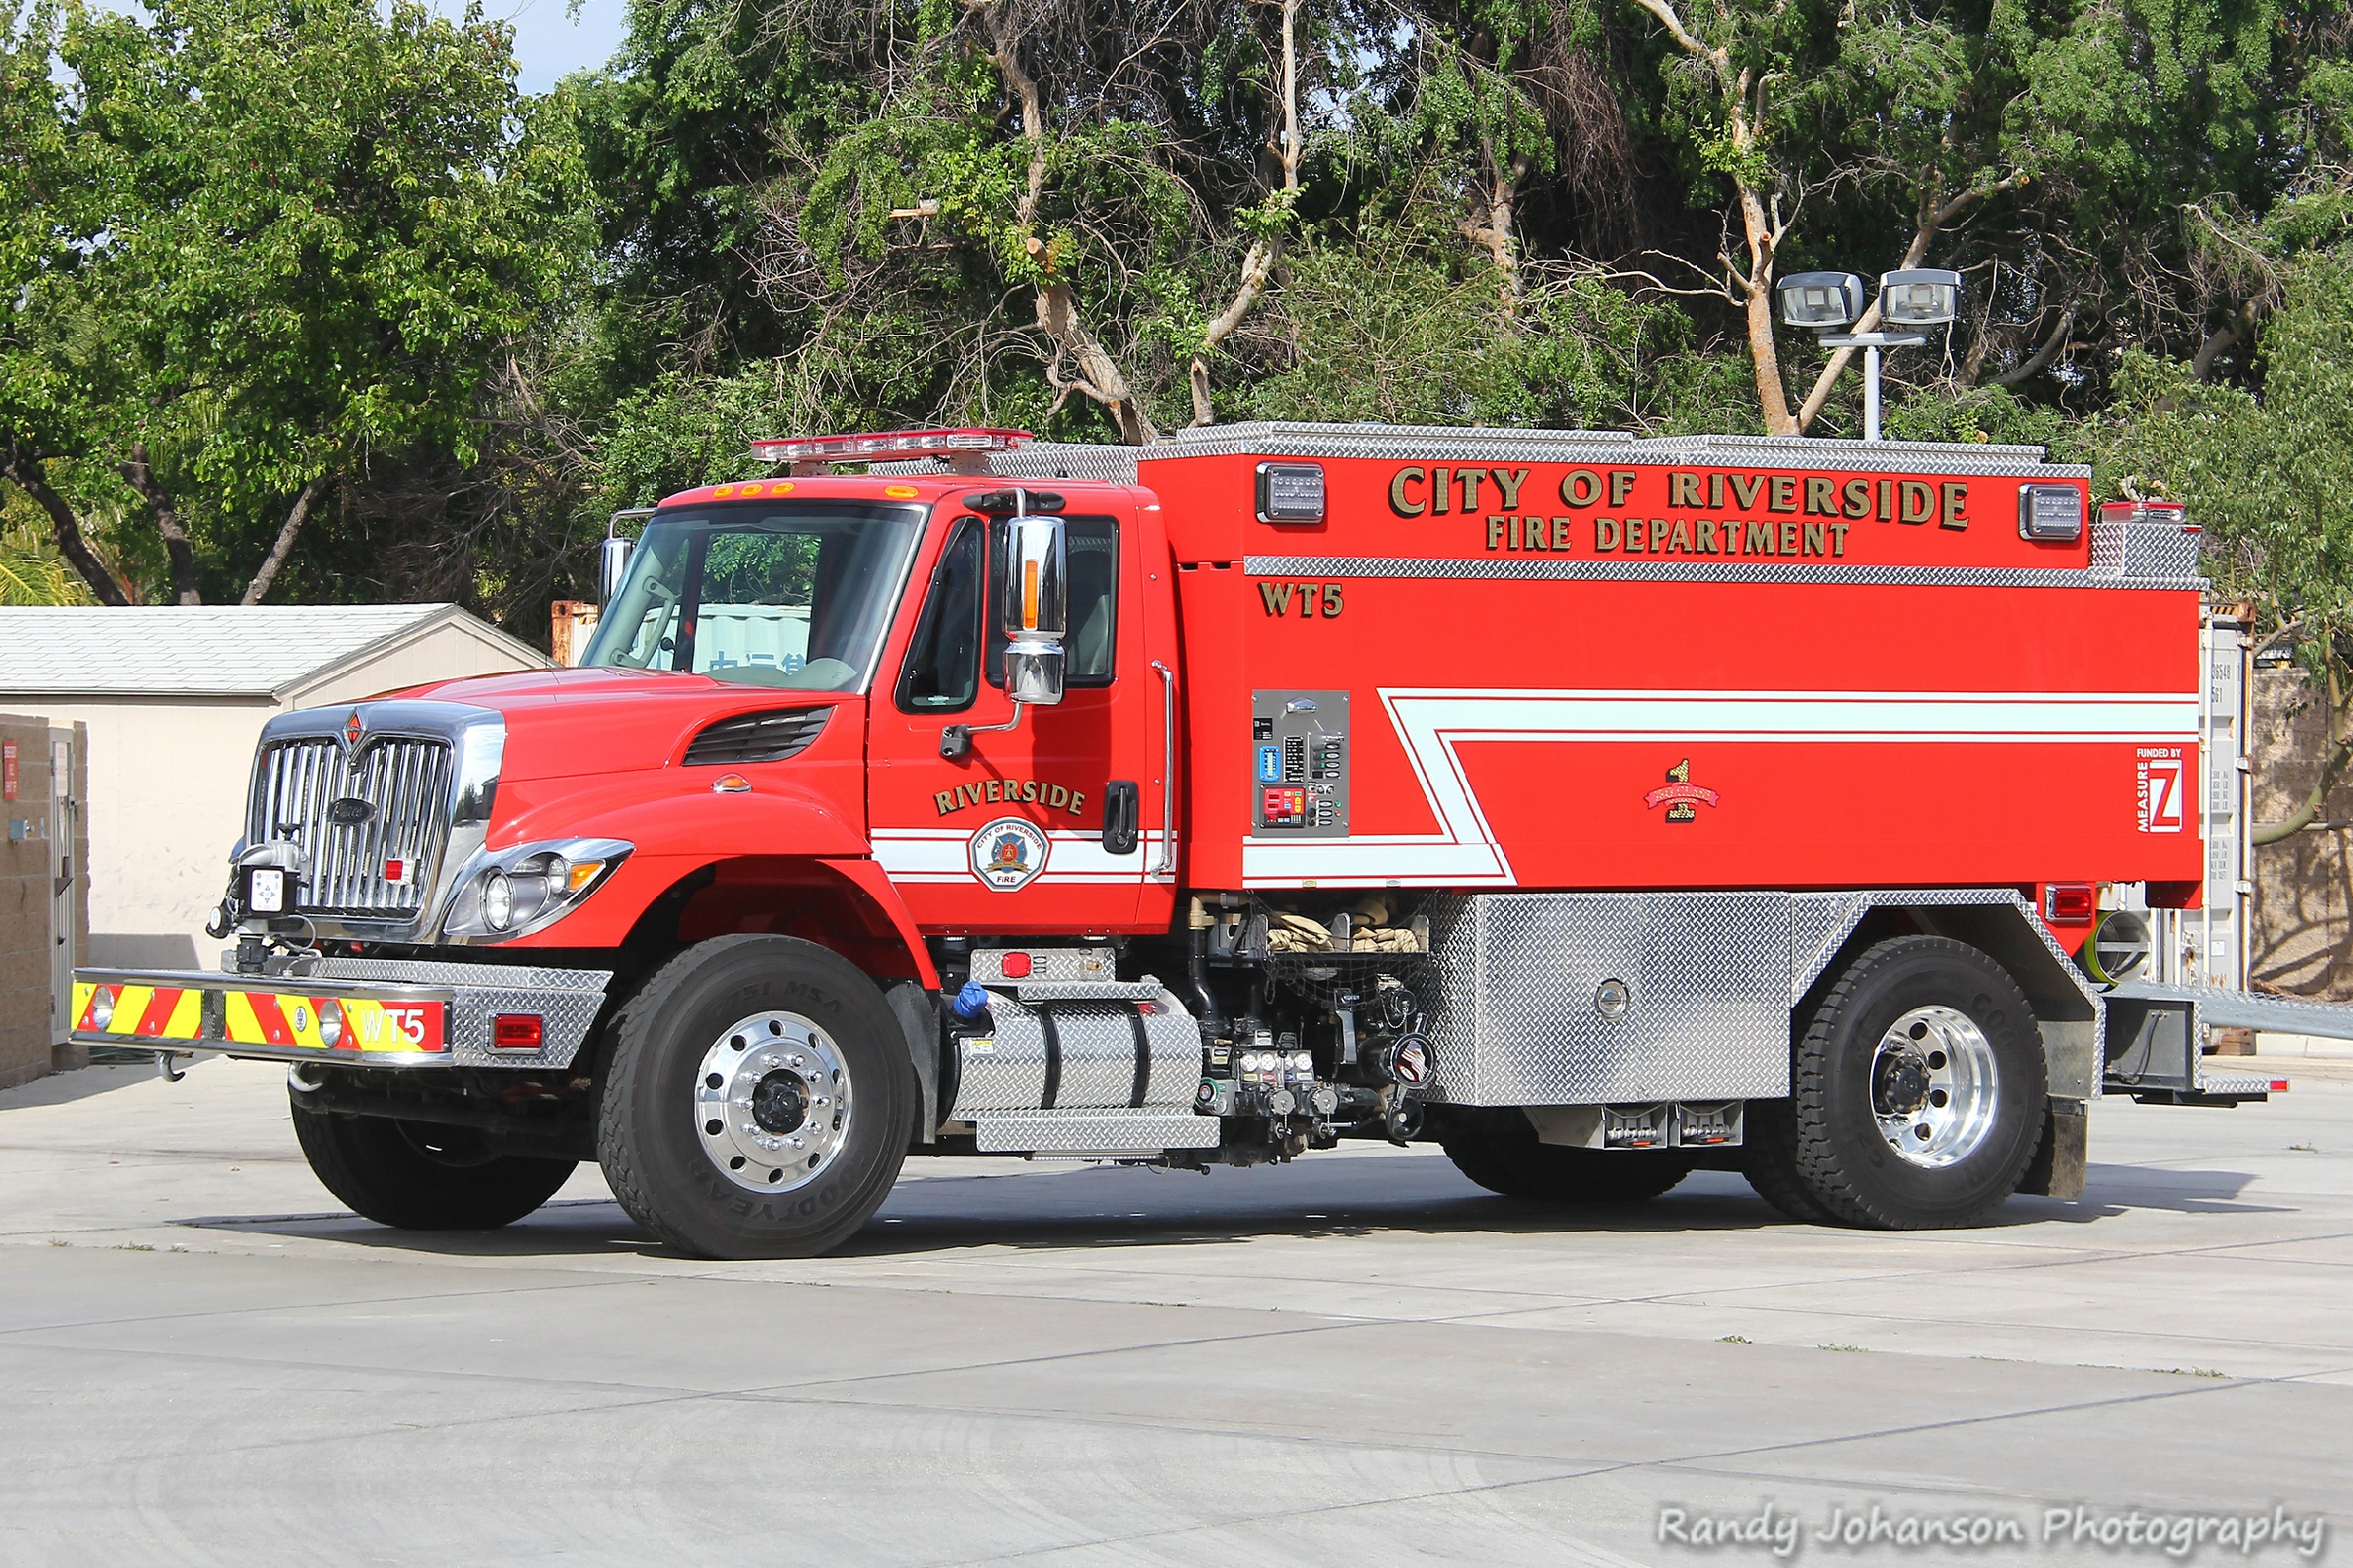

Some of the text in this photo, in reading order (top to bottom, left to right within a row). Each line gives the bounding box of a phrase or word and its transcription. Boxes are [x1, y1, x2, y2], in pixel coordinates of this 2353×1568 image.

[1388, 466, 1969, 531] CITY OF RIVERSIDE
[1486, 515, 1850, 558] FIRE DEPARTMENT
[1257, 582, 1344, 618] WT5
[2137, 748, 2182, 758] FUNDED BY
[934, 778, 1085, 816] RIVERSIDE
[2137, 761, 2149, 832] MEASURE
[2150, 764, 2181, 828] Z
[976, 830, 993, 849] CITY
[995, 824, 1005, 834] OF
[1006, 824, 1043, 851] RIVERSIDE
[362, 1009, 424, 1044] WT5
